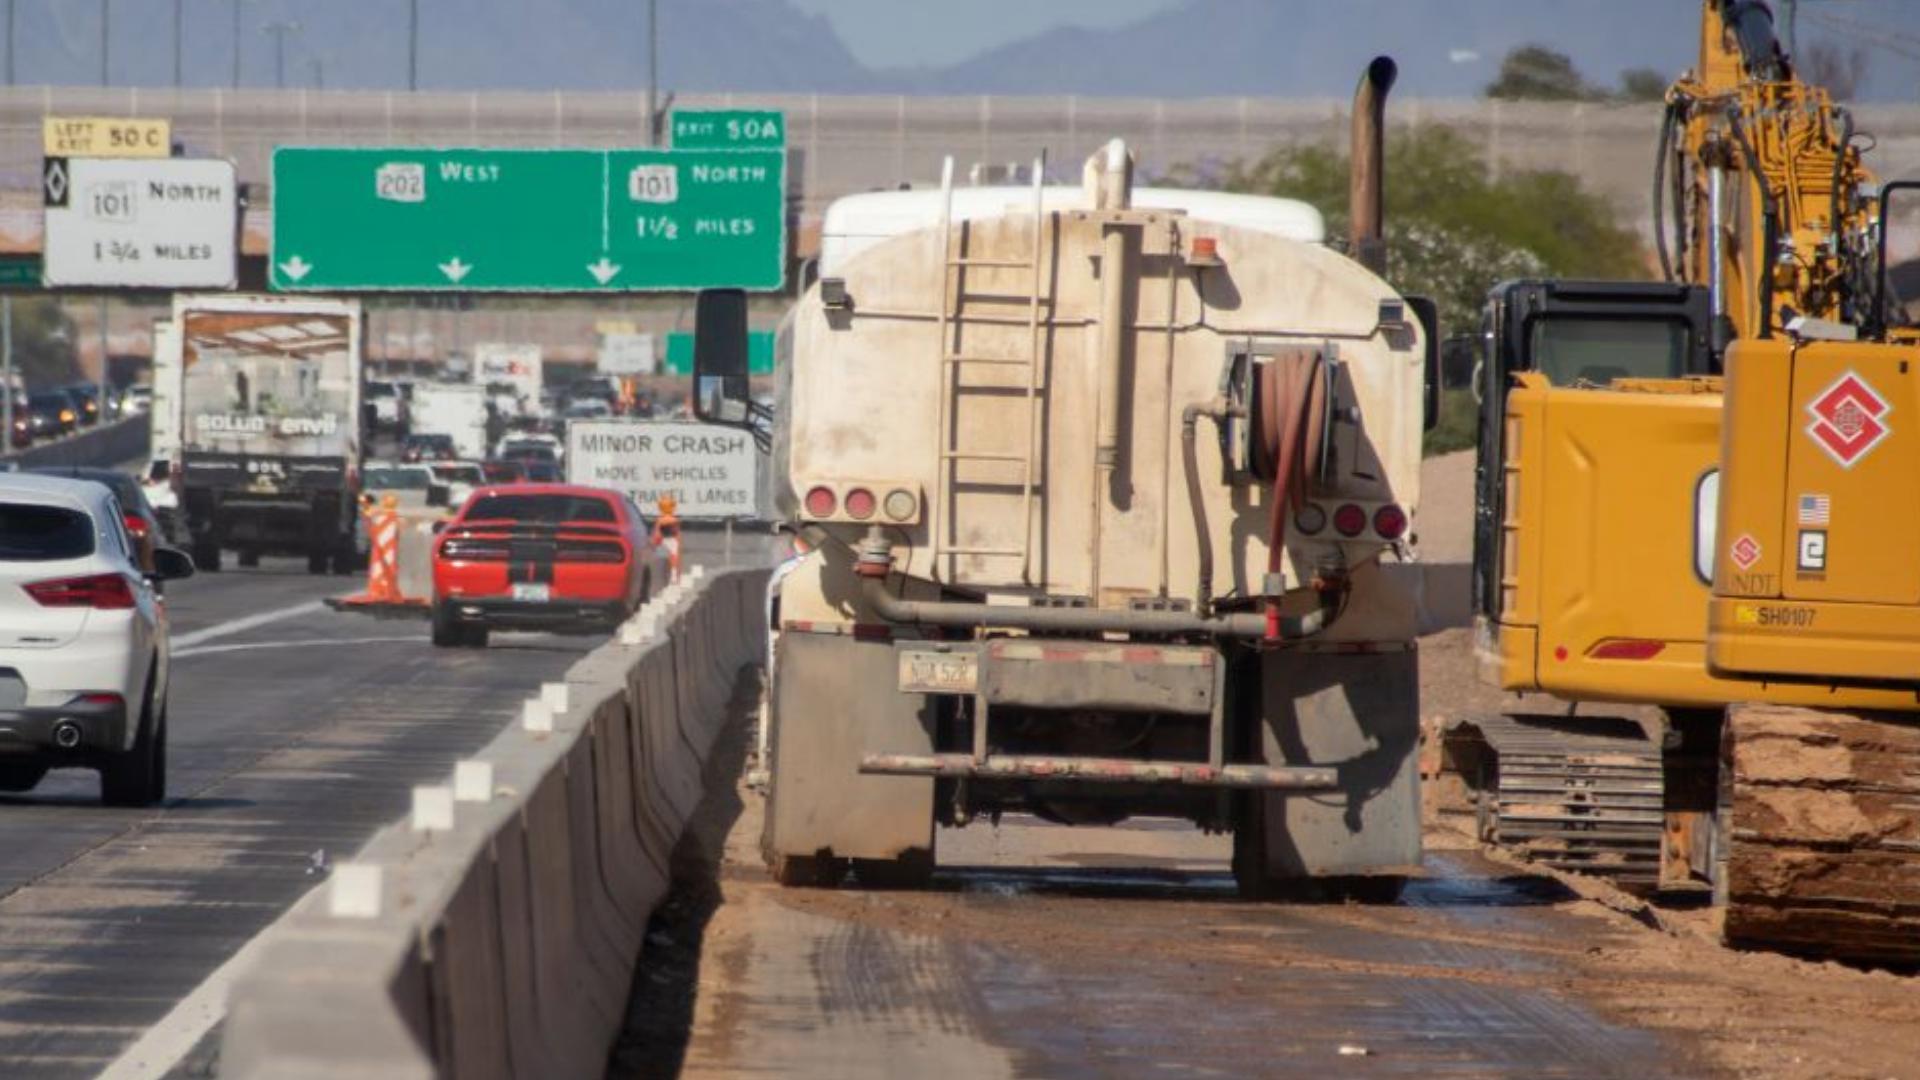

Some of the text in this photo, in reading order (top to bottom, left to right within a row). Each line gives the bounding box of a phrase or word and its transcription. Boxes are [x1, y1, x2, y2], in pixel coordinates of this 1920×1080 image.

[55, 122, 94, 136] LEFT
[677, 118, 778, 140] EXIT 50A
[56, 137, 92, 150] EXIT
[381, 162, 500, 195] 202 WEST
[636, 165, 766, 196] 101 NORTH
[94, 181, 221, 216] 101 NORTH
[695, 217, 755, 236] MILES
[153, 244, 212, 260] MILES
[580, 434, 745, 455] MINOR CRASH
[595, 465, 728, 482] MOVE VEHICLES
[697, 488, 747, 504] LANES
[1757, 606, 1817, 626] SH0107
